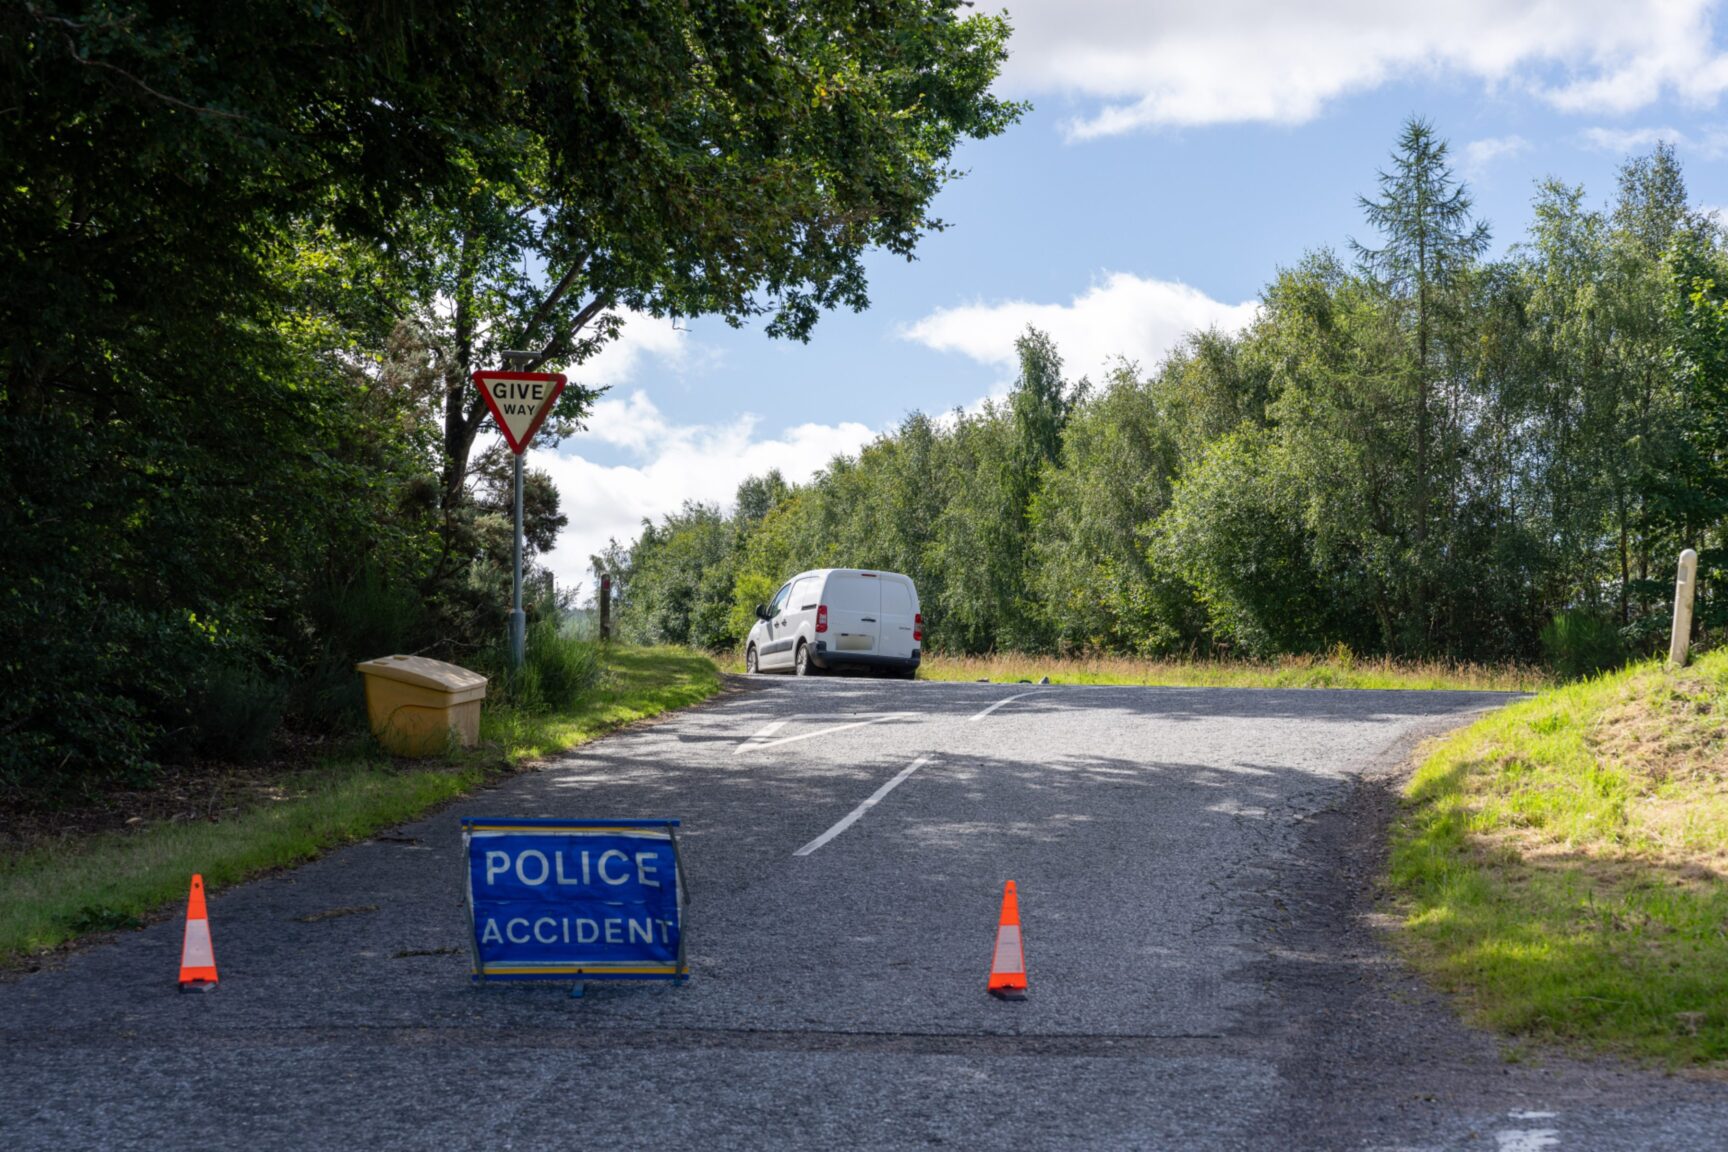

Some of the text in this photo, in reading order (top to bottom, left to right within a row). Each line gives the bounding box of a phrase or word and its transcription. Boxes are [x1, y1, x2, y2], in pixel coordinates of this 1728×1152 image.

[493, 383, 543, 400] GIVE
[504, 404, 535, 415] WAY
[485, 849, 660, 887] POLICE
[481, 917, 673, 944] ACCIDENT
